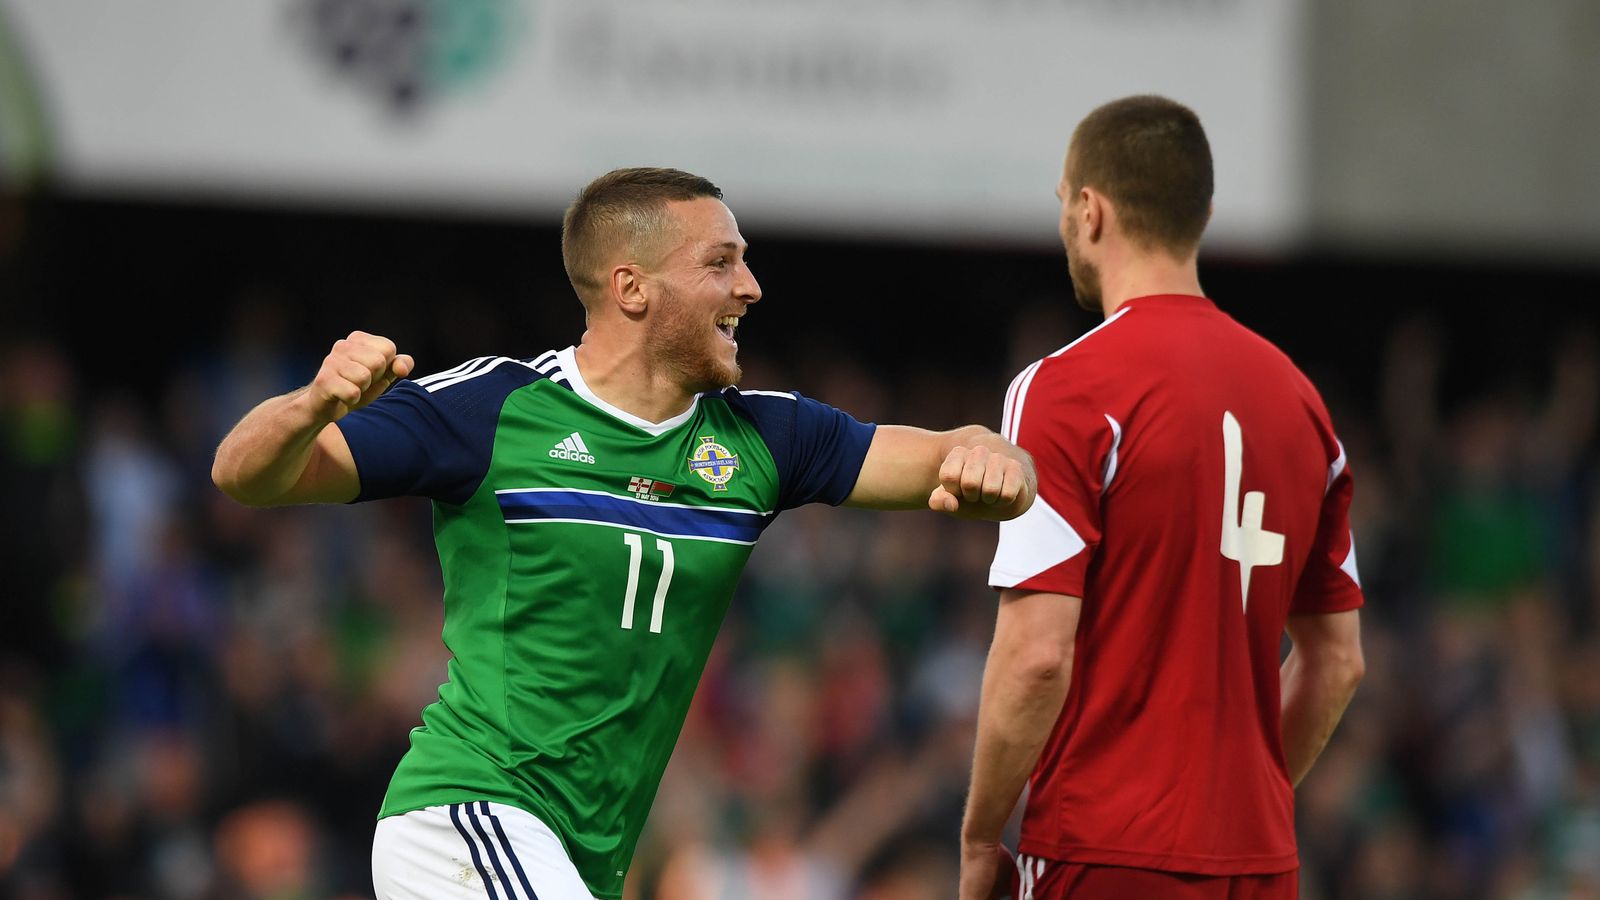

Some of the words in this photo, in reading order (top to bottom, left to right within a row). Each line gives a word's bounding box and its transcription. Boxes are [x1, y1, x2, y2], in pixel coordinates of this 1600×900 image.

[548, 448, 596, 464] adidas
[705, 445, 727, 454] FOOTBALL
[1220, 410, 1285, 615] 4
[621, 532, 675, 634] 11
